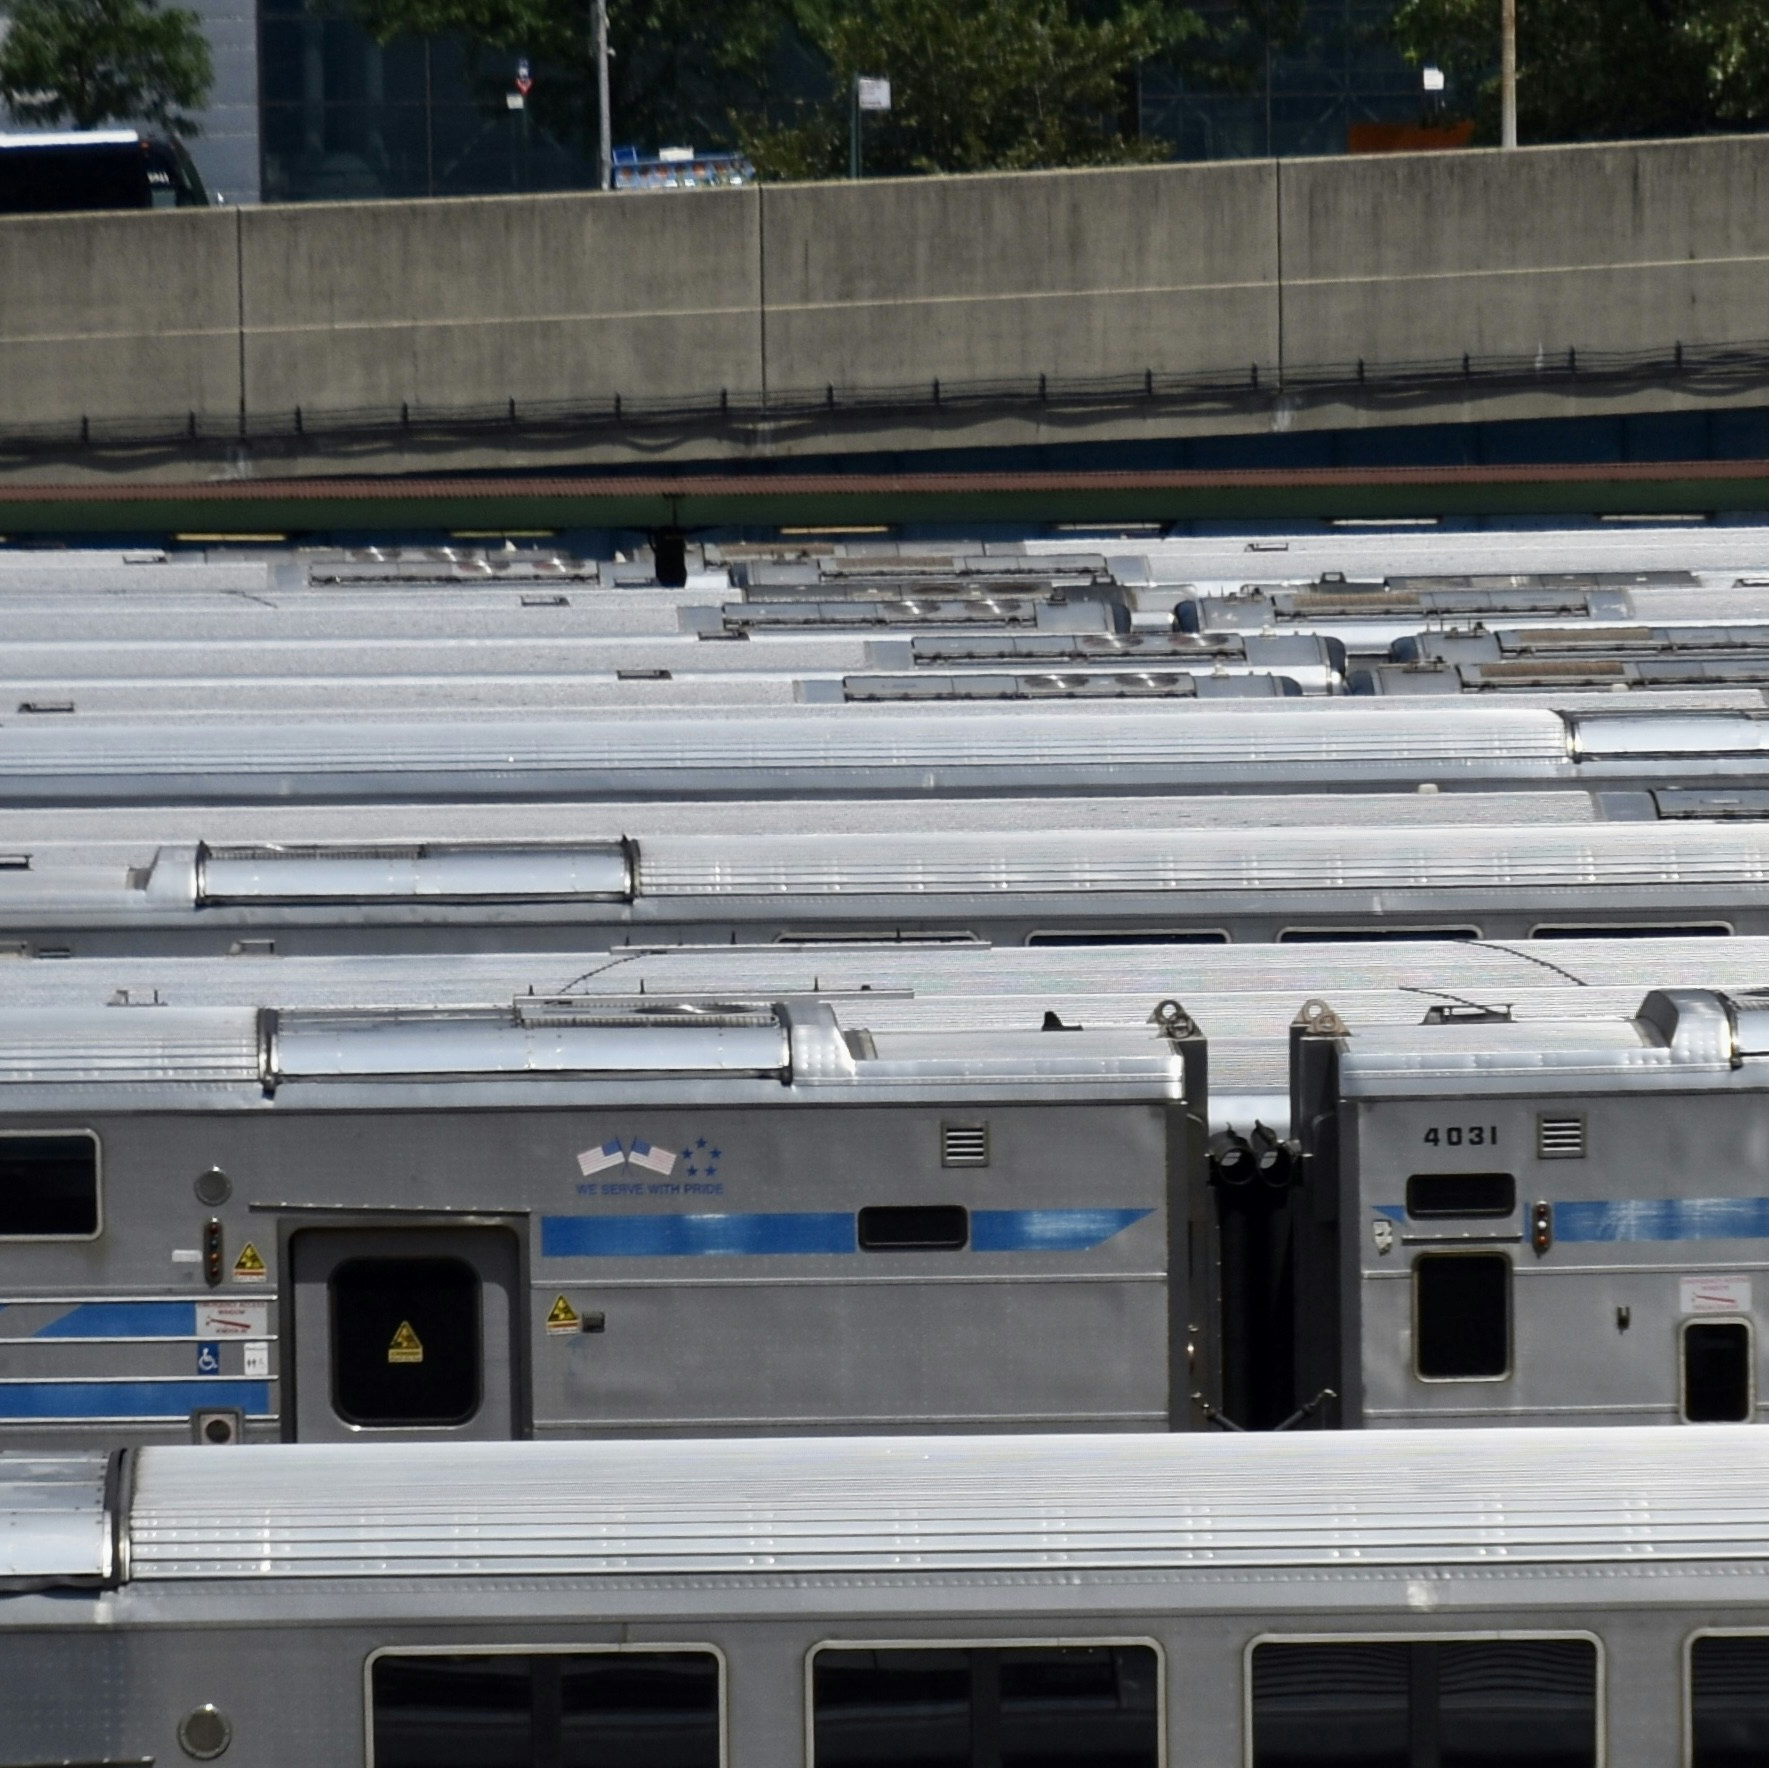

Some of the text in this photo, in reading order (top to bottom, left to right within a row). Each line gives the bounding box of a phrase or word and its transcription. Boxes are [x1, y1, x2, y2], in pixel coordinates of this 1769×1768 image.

[1424, 1126, 1497, 1146] 4031
[576, 1183, 725, 1195] WE SERVE WITH PRIDE
